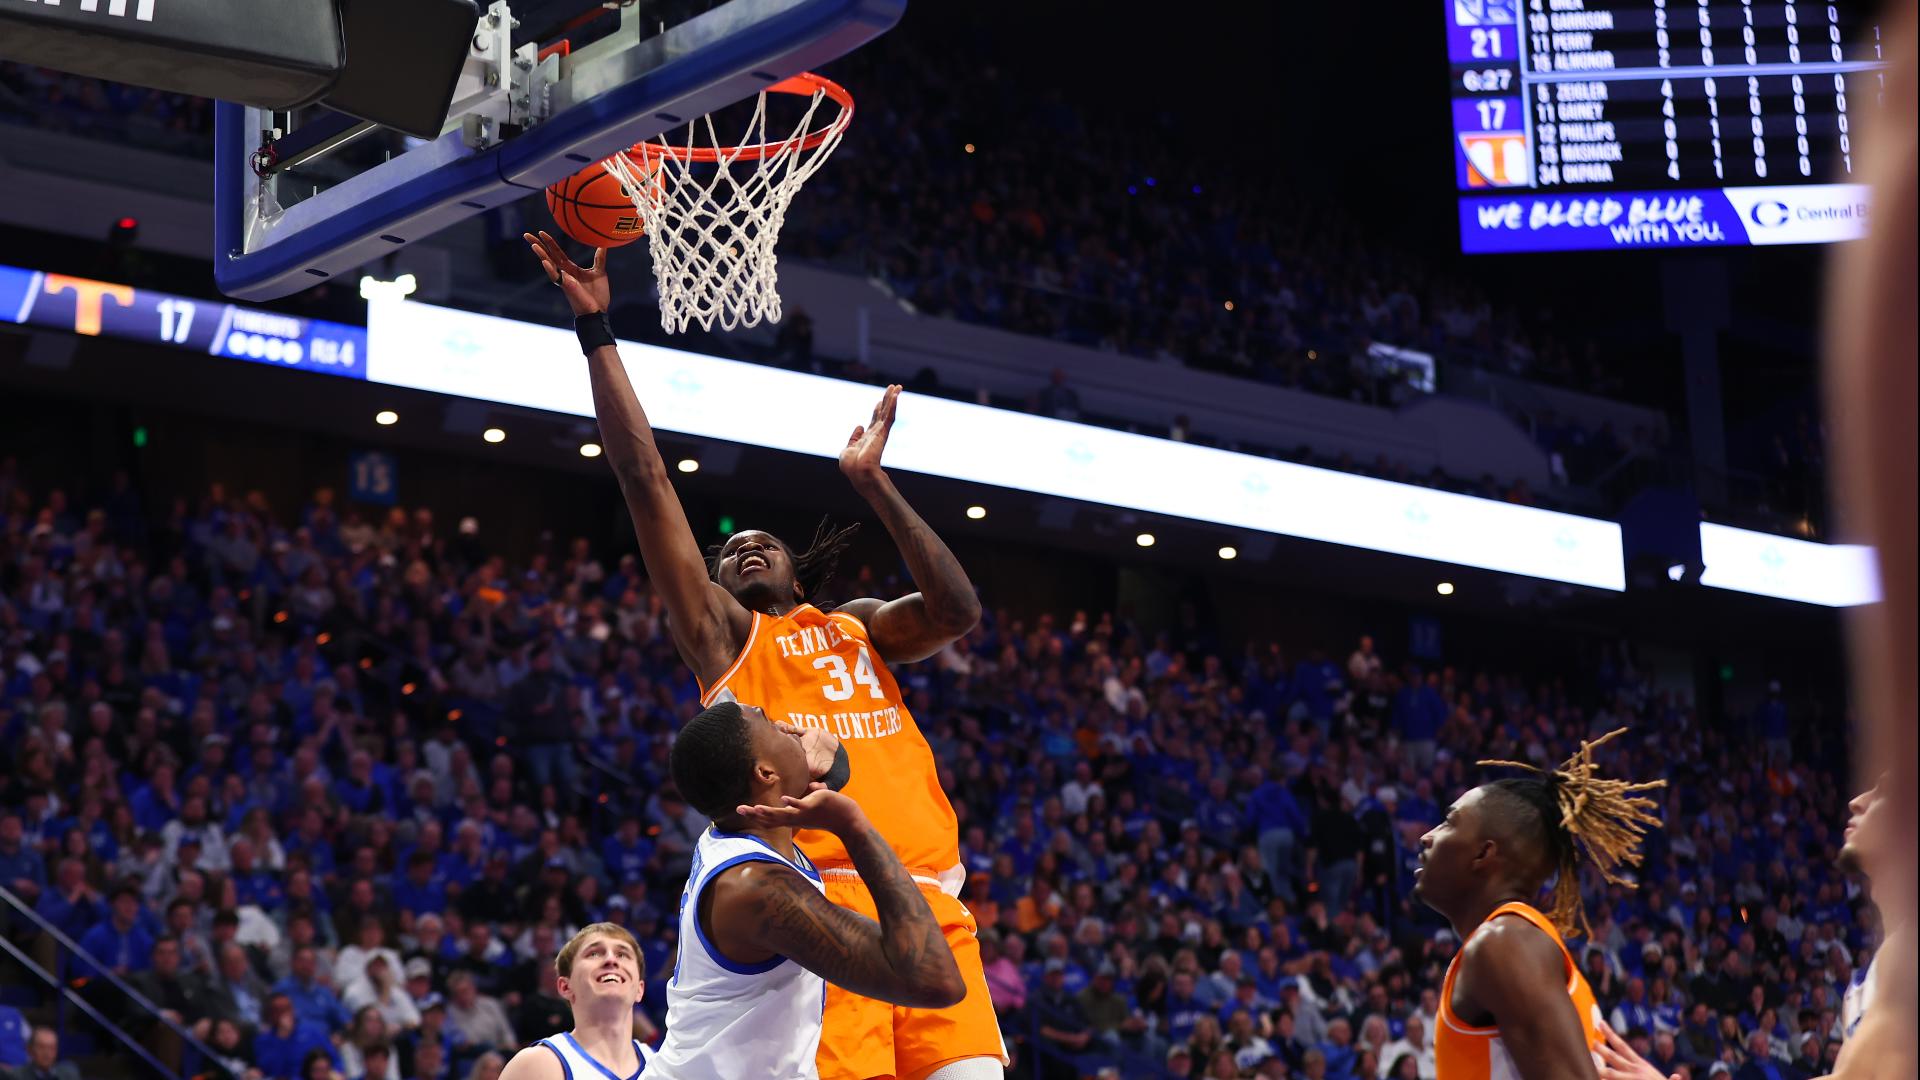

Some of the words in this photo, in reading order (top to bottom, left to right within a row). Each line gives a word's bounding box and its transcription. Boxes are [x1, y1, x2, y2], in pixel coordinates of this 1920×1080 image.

[1655, 8, 1667, 28] 2
[1743, 6, 1753, 25] 1
[1785, 4, 1797, 24] 0
[1828, 5, 1839, 23] 0
[1470, 27, 1502, 58] 21
[1531, 33, 1550, 52] 11
[1552, 31, 1593, 51] PERRY
[1657, 28, 1669, 49] 0
[1700, 27, 1712, 47] 0
[1743, 25, 1755, 46] 0
[1787, 24, 1799, 44] 0
[1829, 24, 1841, 43] 0
[1659, 48, 1671, 68] 2
[1702, 47, 1714, 67] 0
[1745, 45, 1756, 65] 0
[1789, 44, 1800, 64] 0
[1831, 43, 1842, 63] 0
[1463, 69, 1512, 91] 6:27
[1661, 79, 1673, 99] 4
[1704, 77, 1716, 98] 0
[1748, 76, 1759, 96] 2
[1792, 74, 1803, 94] 0
[1834, 73, 1844, 93] 0
[1476, 99, 1506, 130] 17
[1536, 102, 1556, 123] 11
[1663, 98, 1675, 118] 4
[1708, 98, 1718, 117] 1
[1750, 95, 1761, 116] 0
[1794, 94, 1805, 114] 0
[1836, 92, 1846, 112] 0
[1558, 121, 1616, 142] PHILLIPS
[1664, 118, 1677, 140] 0
[1709, 118, 1720, 138] 1
[1751, 116, 1763, 136] 0
[1795, 114, 1807, 135] 0
[1838, 113, 1848, 133] 0
[1666, 139, 1678, 160] 0
[1711, 138, 1721, 158] 1
[1753, 137, 1765, 157] 0
[1797, 135, 1809, 156] 0
[1839, 133, 1850, 153] 0
[1538, 163, 1561, 186] 34
[1668, 160, 1680, 180] 4
[1713, 158, 1723, 179] 1
[1755, 157, 1767, 178] 0
[1799, 155, 1811, 176] 0
[1843, 154, 1852, 174] 1
[1478, 201, 1523, 230] WE
[1529, 196, 1623, 231] BLEED
[1628, 195, 1703, 224] BLUE
[1797, 205, 1852, 229] Central
[1609, 222, 1669, 244] WITH
[1672, 220, 1725, 242] YOU.
[44, 272, 135, 337] T
[157, 298, 196, 344] 17
[776, 620, 853, 658] TENNE
[812, 646, 884, 701] 34
